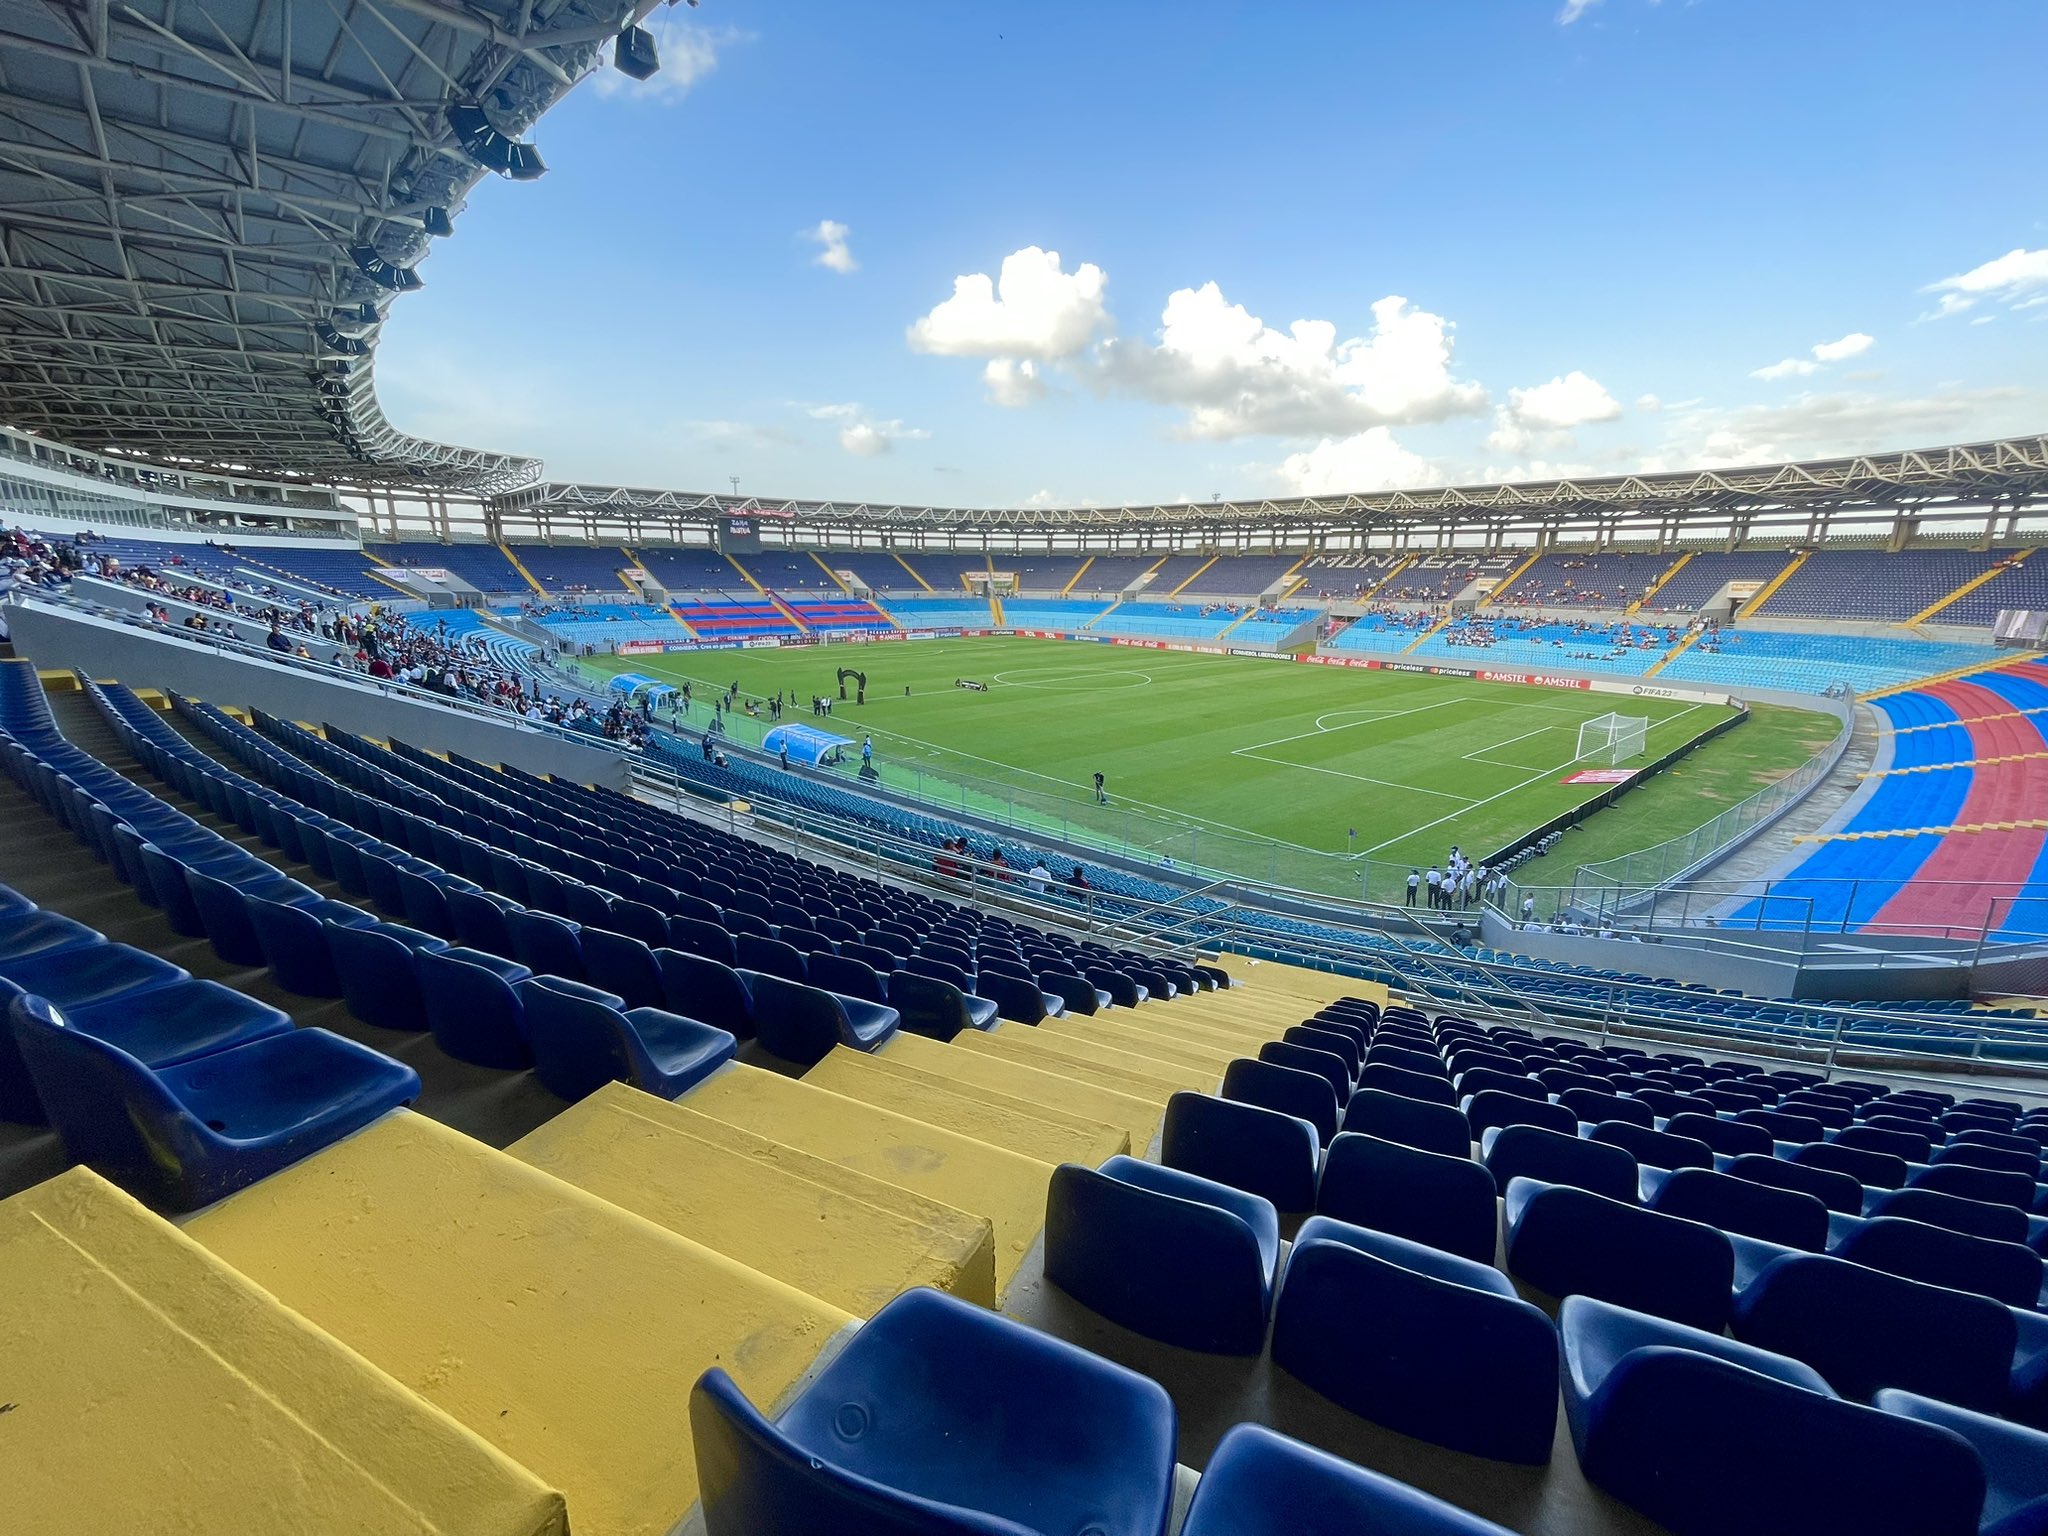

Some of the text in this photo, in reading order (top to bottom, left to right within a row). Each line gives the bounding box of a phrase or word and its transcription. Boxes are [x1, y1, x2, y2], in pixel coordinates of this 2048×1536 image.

[719, 642, 737, 650] grande
[1232, 649, 1257, 657] CONMEBOL
[1258, 651, 1291, 661] LIBERTADORES
[1307, 655, 1368, 668] Coca-Cola Coca-Cola Coca-Cola
[1394, 663, 1470, 677] priceless priceless
[1492, 672, 1581, 689] AMSTEL AMSTEL
[1643, 688, 1661, 697] FIFA
[1661, 688, 1673, 698] 23
